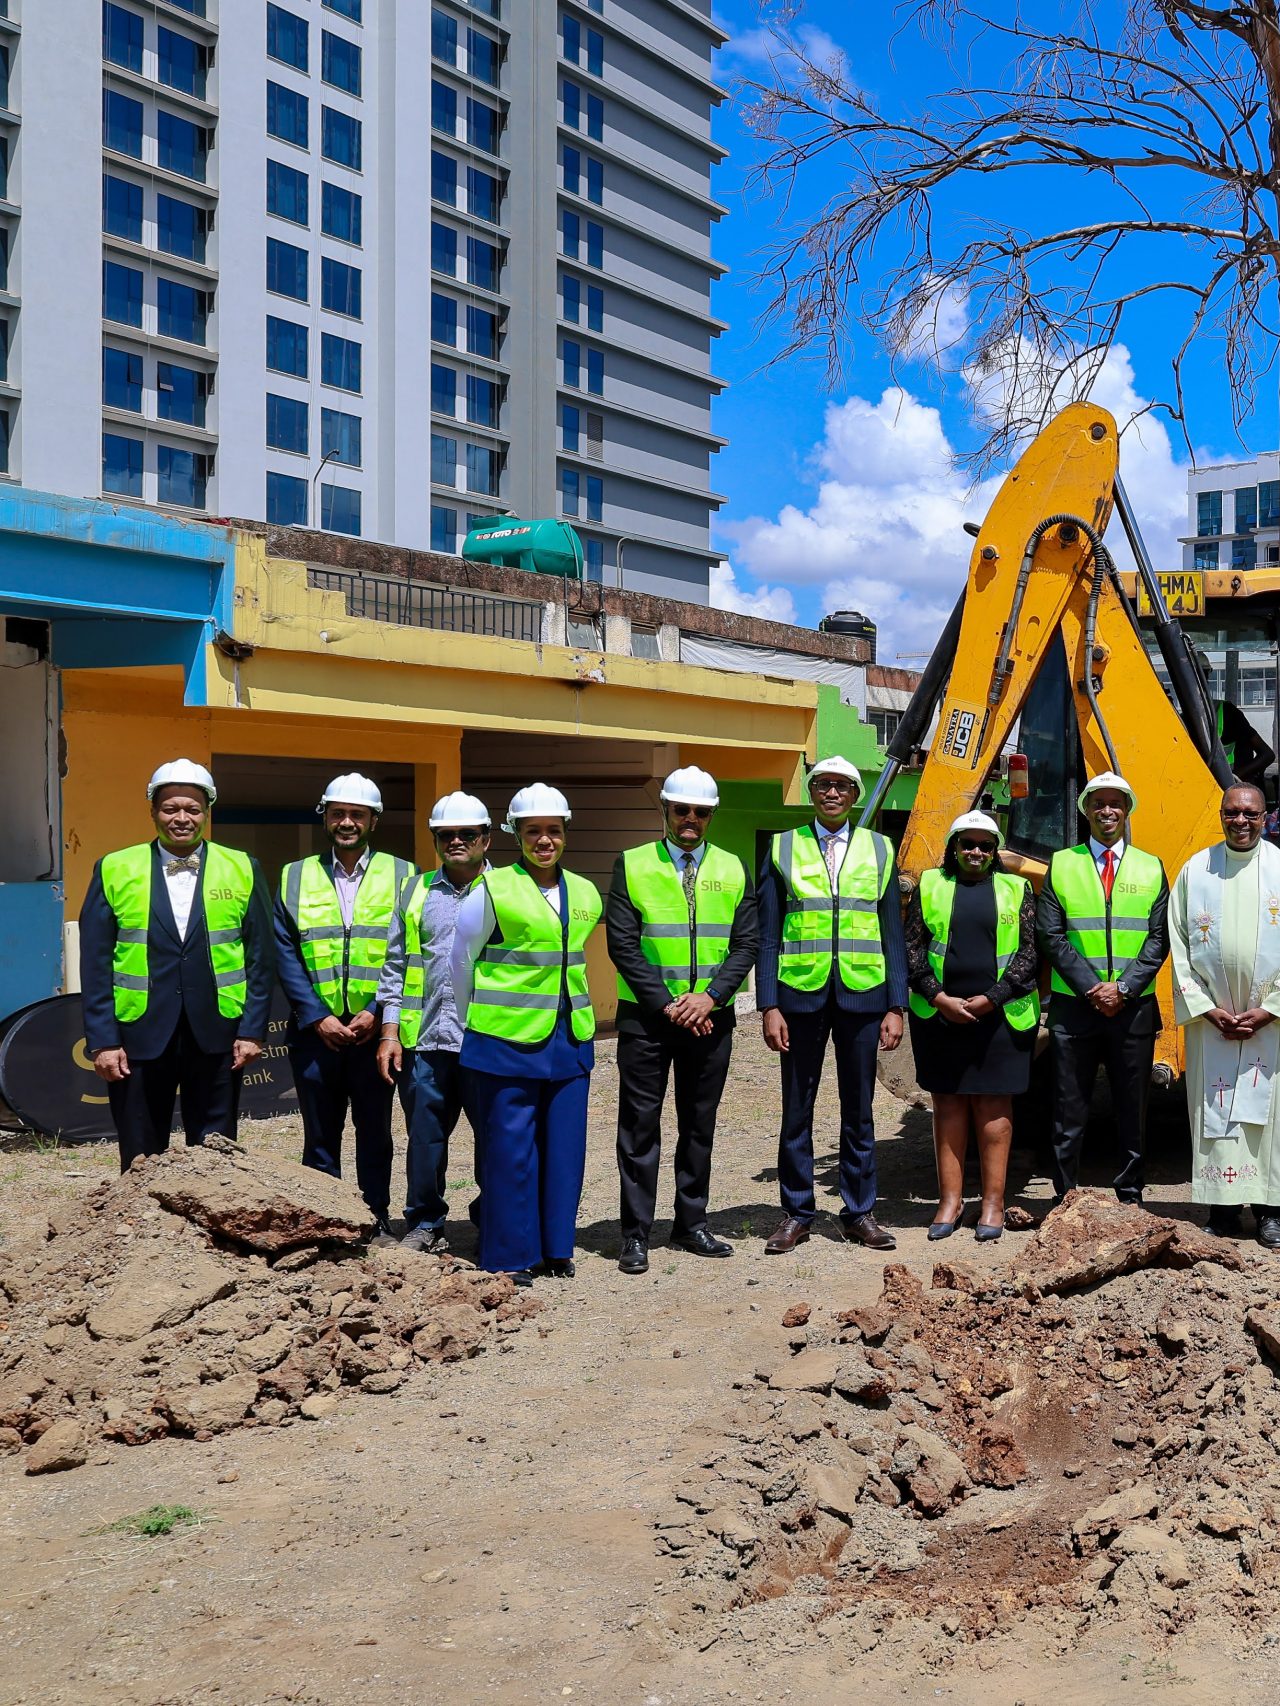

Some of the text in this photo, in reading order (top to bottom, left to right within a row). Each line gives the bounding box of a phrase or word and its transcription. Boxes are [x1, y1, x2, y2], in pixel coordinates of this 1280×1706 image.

[1145, 575, 1196, 595] HMA
[954, 712, 975, 758] JCB
[700, 880, 722, 892] SIB
[1118, 882, 1137, 894] SIB
[209, 888, 233, 901] SIB
[573, 908, 589, 921] SIB
[1000, 913, 1015, 925] SIB
[268, 1020, 288, 1033] ar
[243, 1069, 274, 1086] ank
